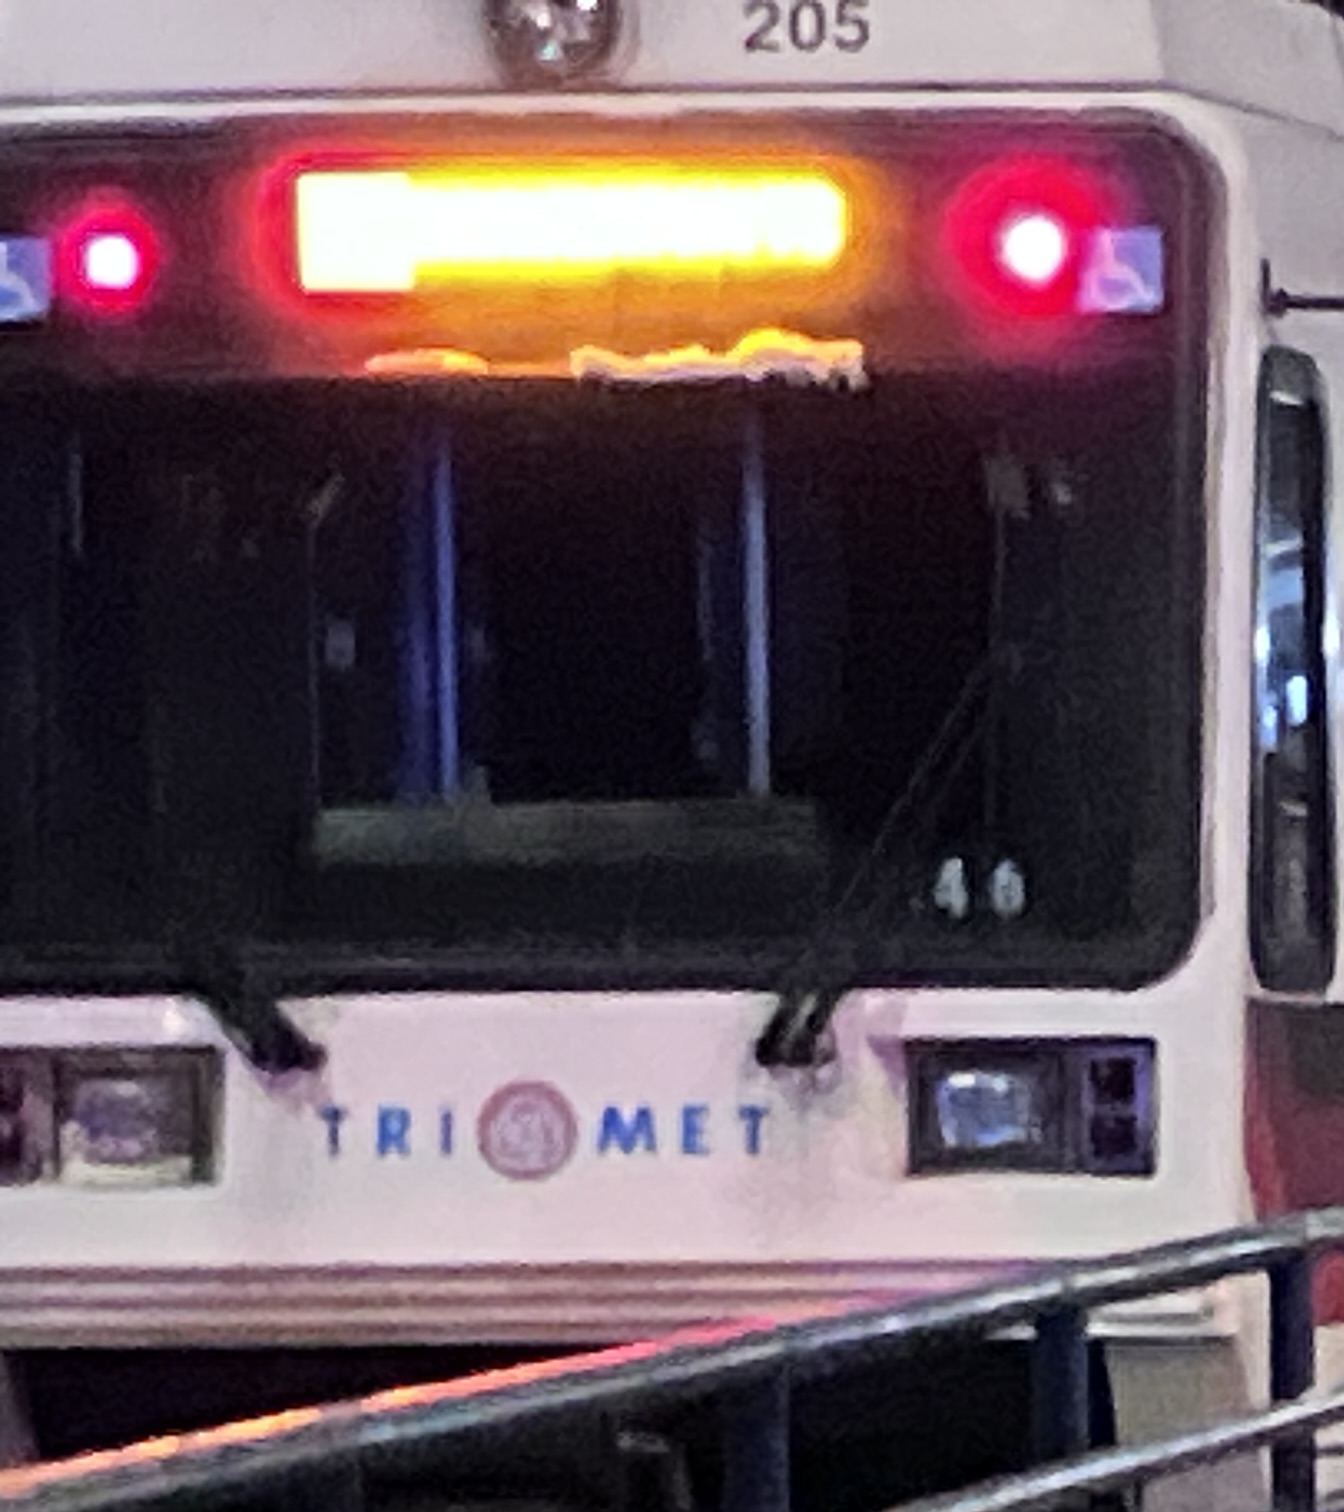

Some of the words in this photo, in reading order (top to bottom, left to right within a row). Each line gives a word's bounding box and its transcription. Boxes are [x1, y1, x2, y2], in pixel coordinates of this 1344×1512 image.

[743, 0, 871, 52] 205
[317, 1105, 456, 1157] TRI
[598, 1105, 770, 1156] MET
